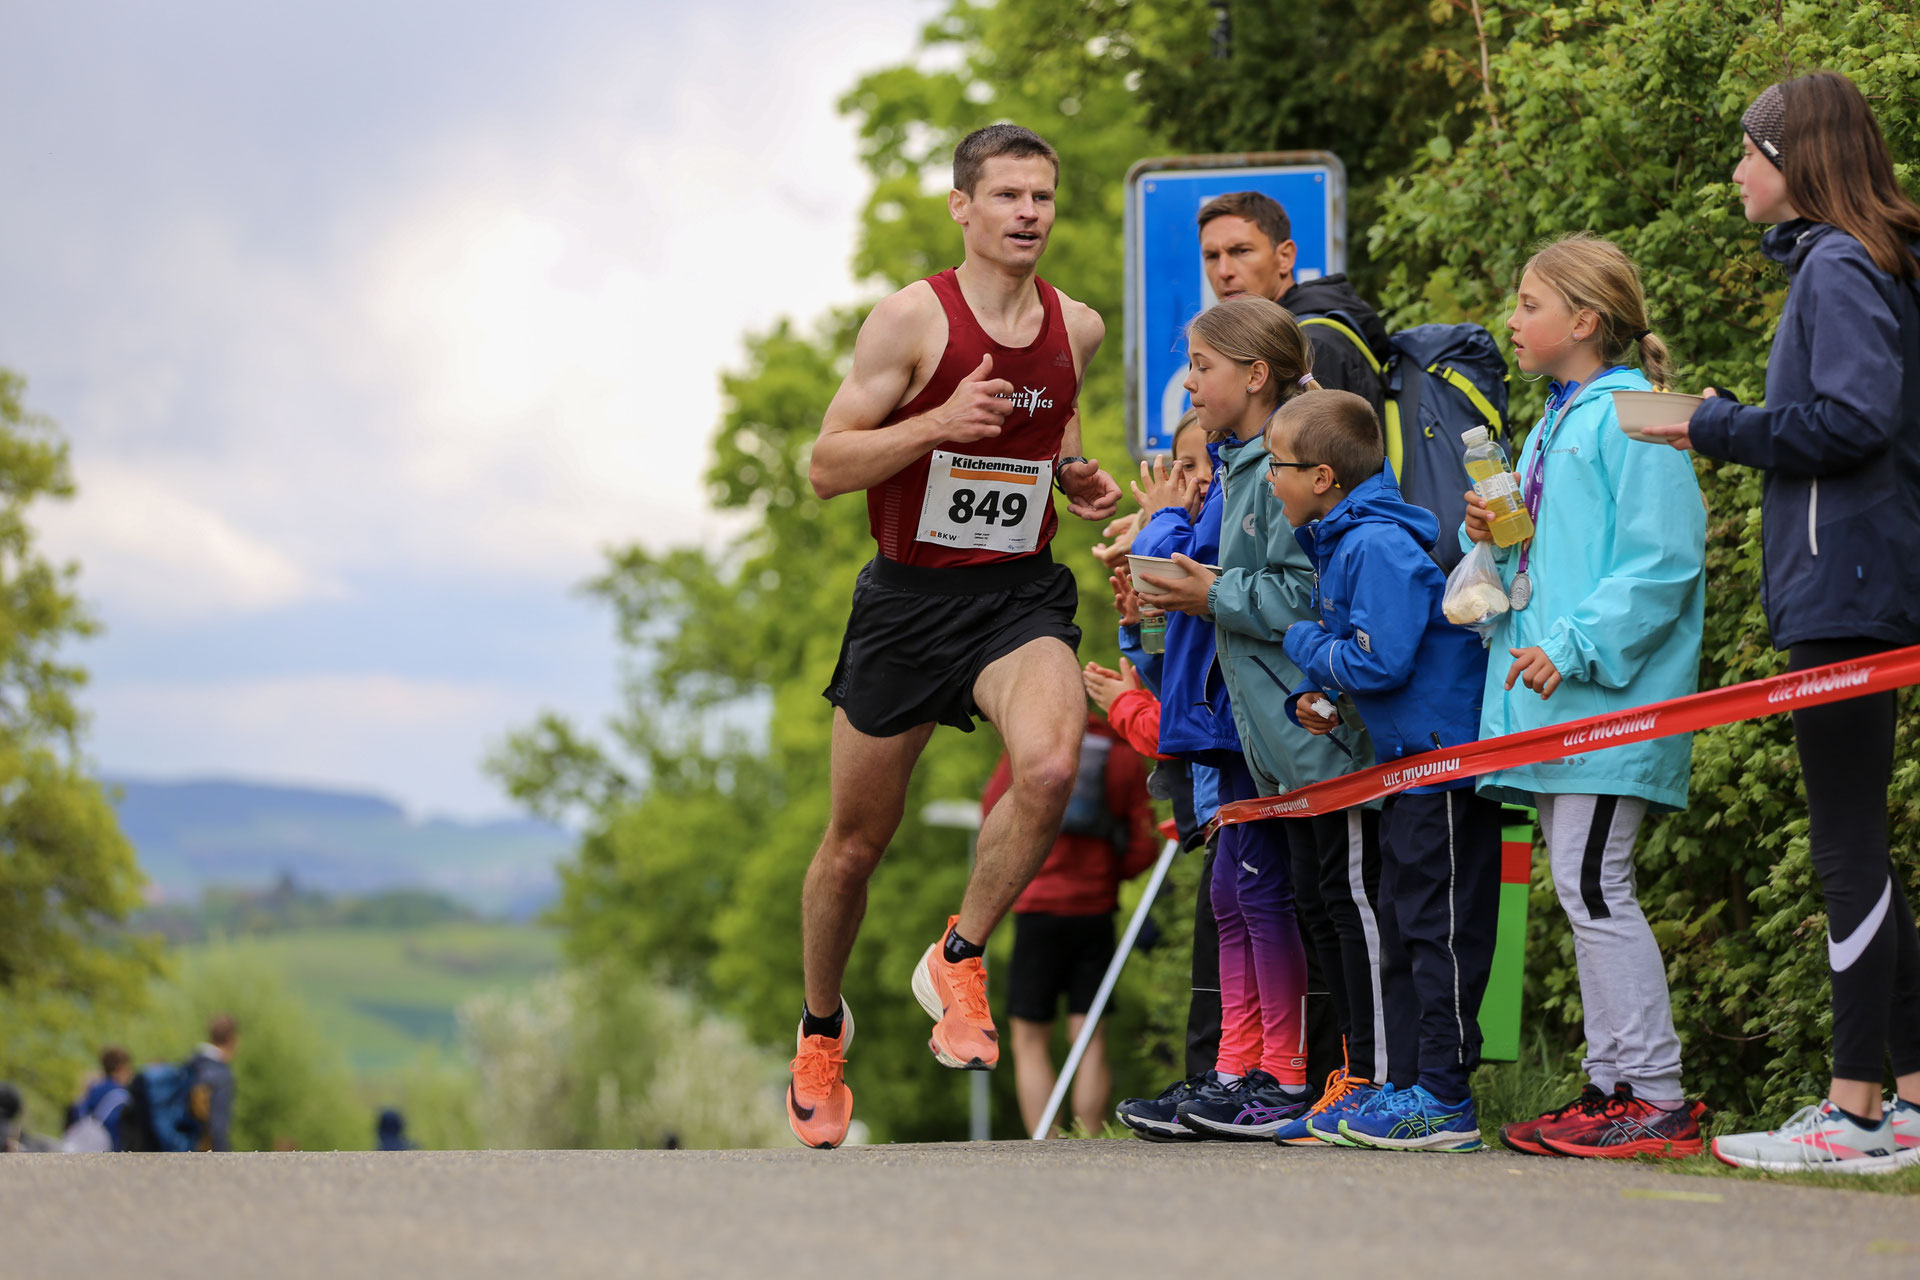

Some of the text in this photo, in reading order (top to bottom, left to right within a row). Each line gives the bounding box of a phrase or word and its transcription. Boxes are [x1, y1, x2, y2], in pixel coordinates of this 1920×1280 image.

[951, 456, 1039, 475] Kilchenmann
[948, 488, 1028, 528] 849
[937, 531, 957, 541] BKW
